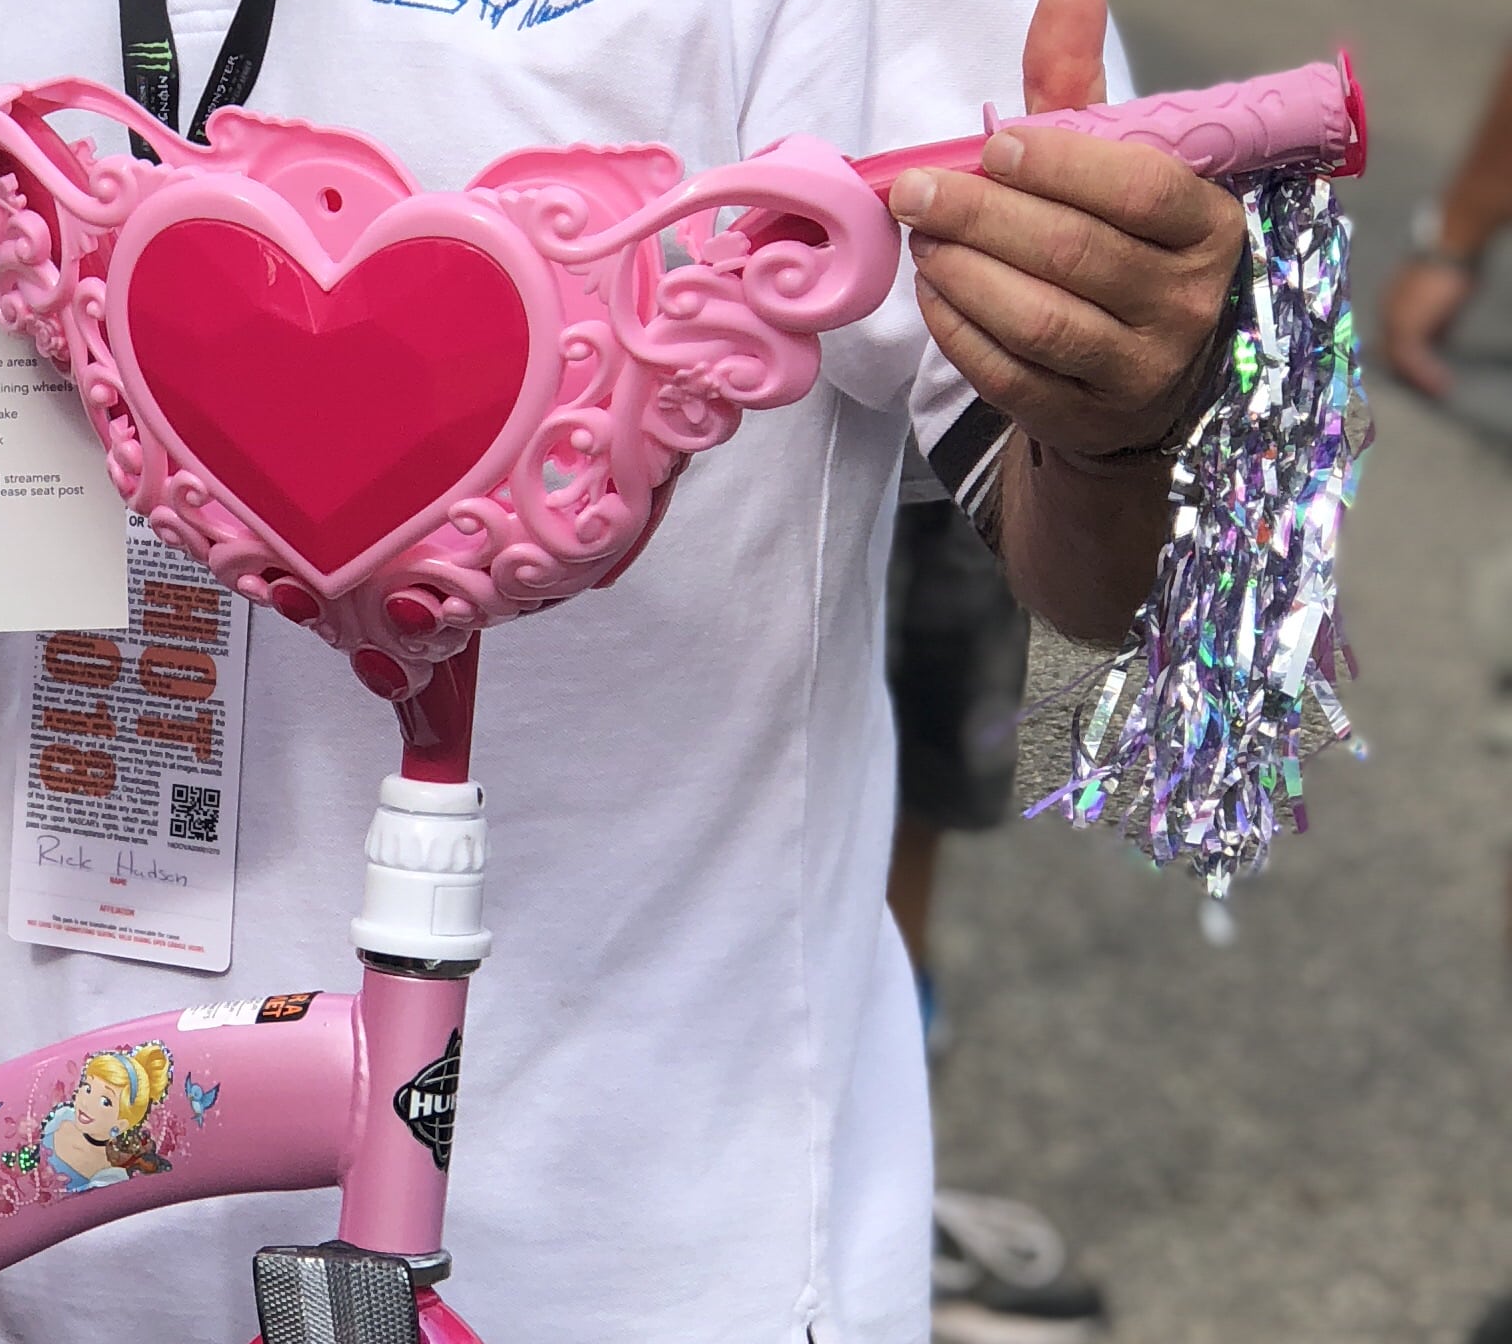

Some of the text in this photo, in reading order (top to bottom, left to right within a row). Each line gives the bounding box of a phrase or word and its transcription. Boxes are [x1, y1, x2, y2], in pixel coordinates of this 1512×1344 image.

[6, 358, 38, 368] areas
[32, 381, 74, 393] wheels
[4, 473, 61, 484] streamers
[30, 485, 55, 497] seat
[58, 484, 85, 499] post
[129, 515, 145, 528] OR
[39, 630, 123, 797] 018
[37, 834, 189, 887] Rick Hudson
